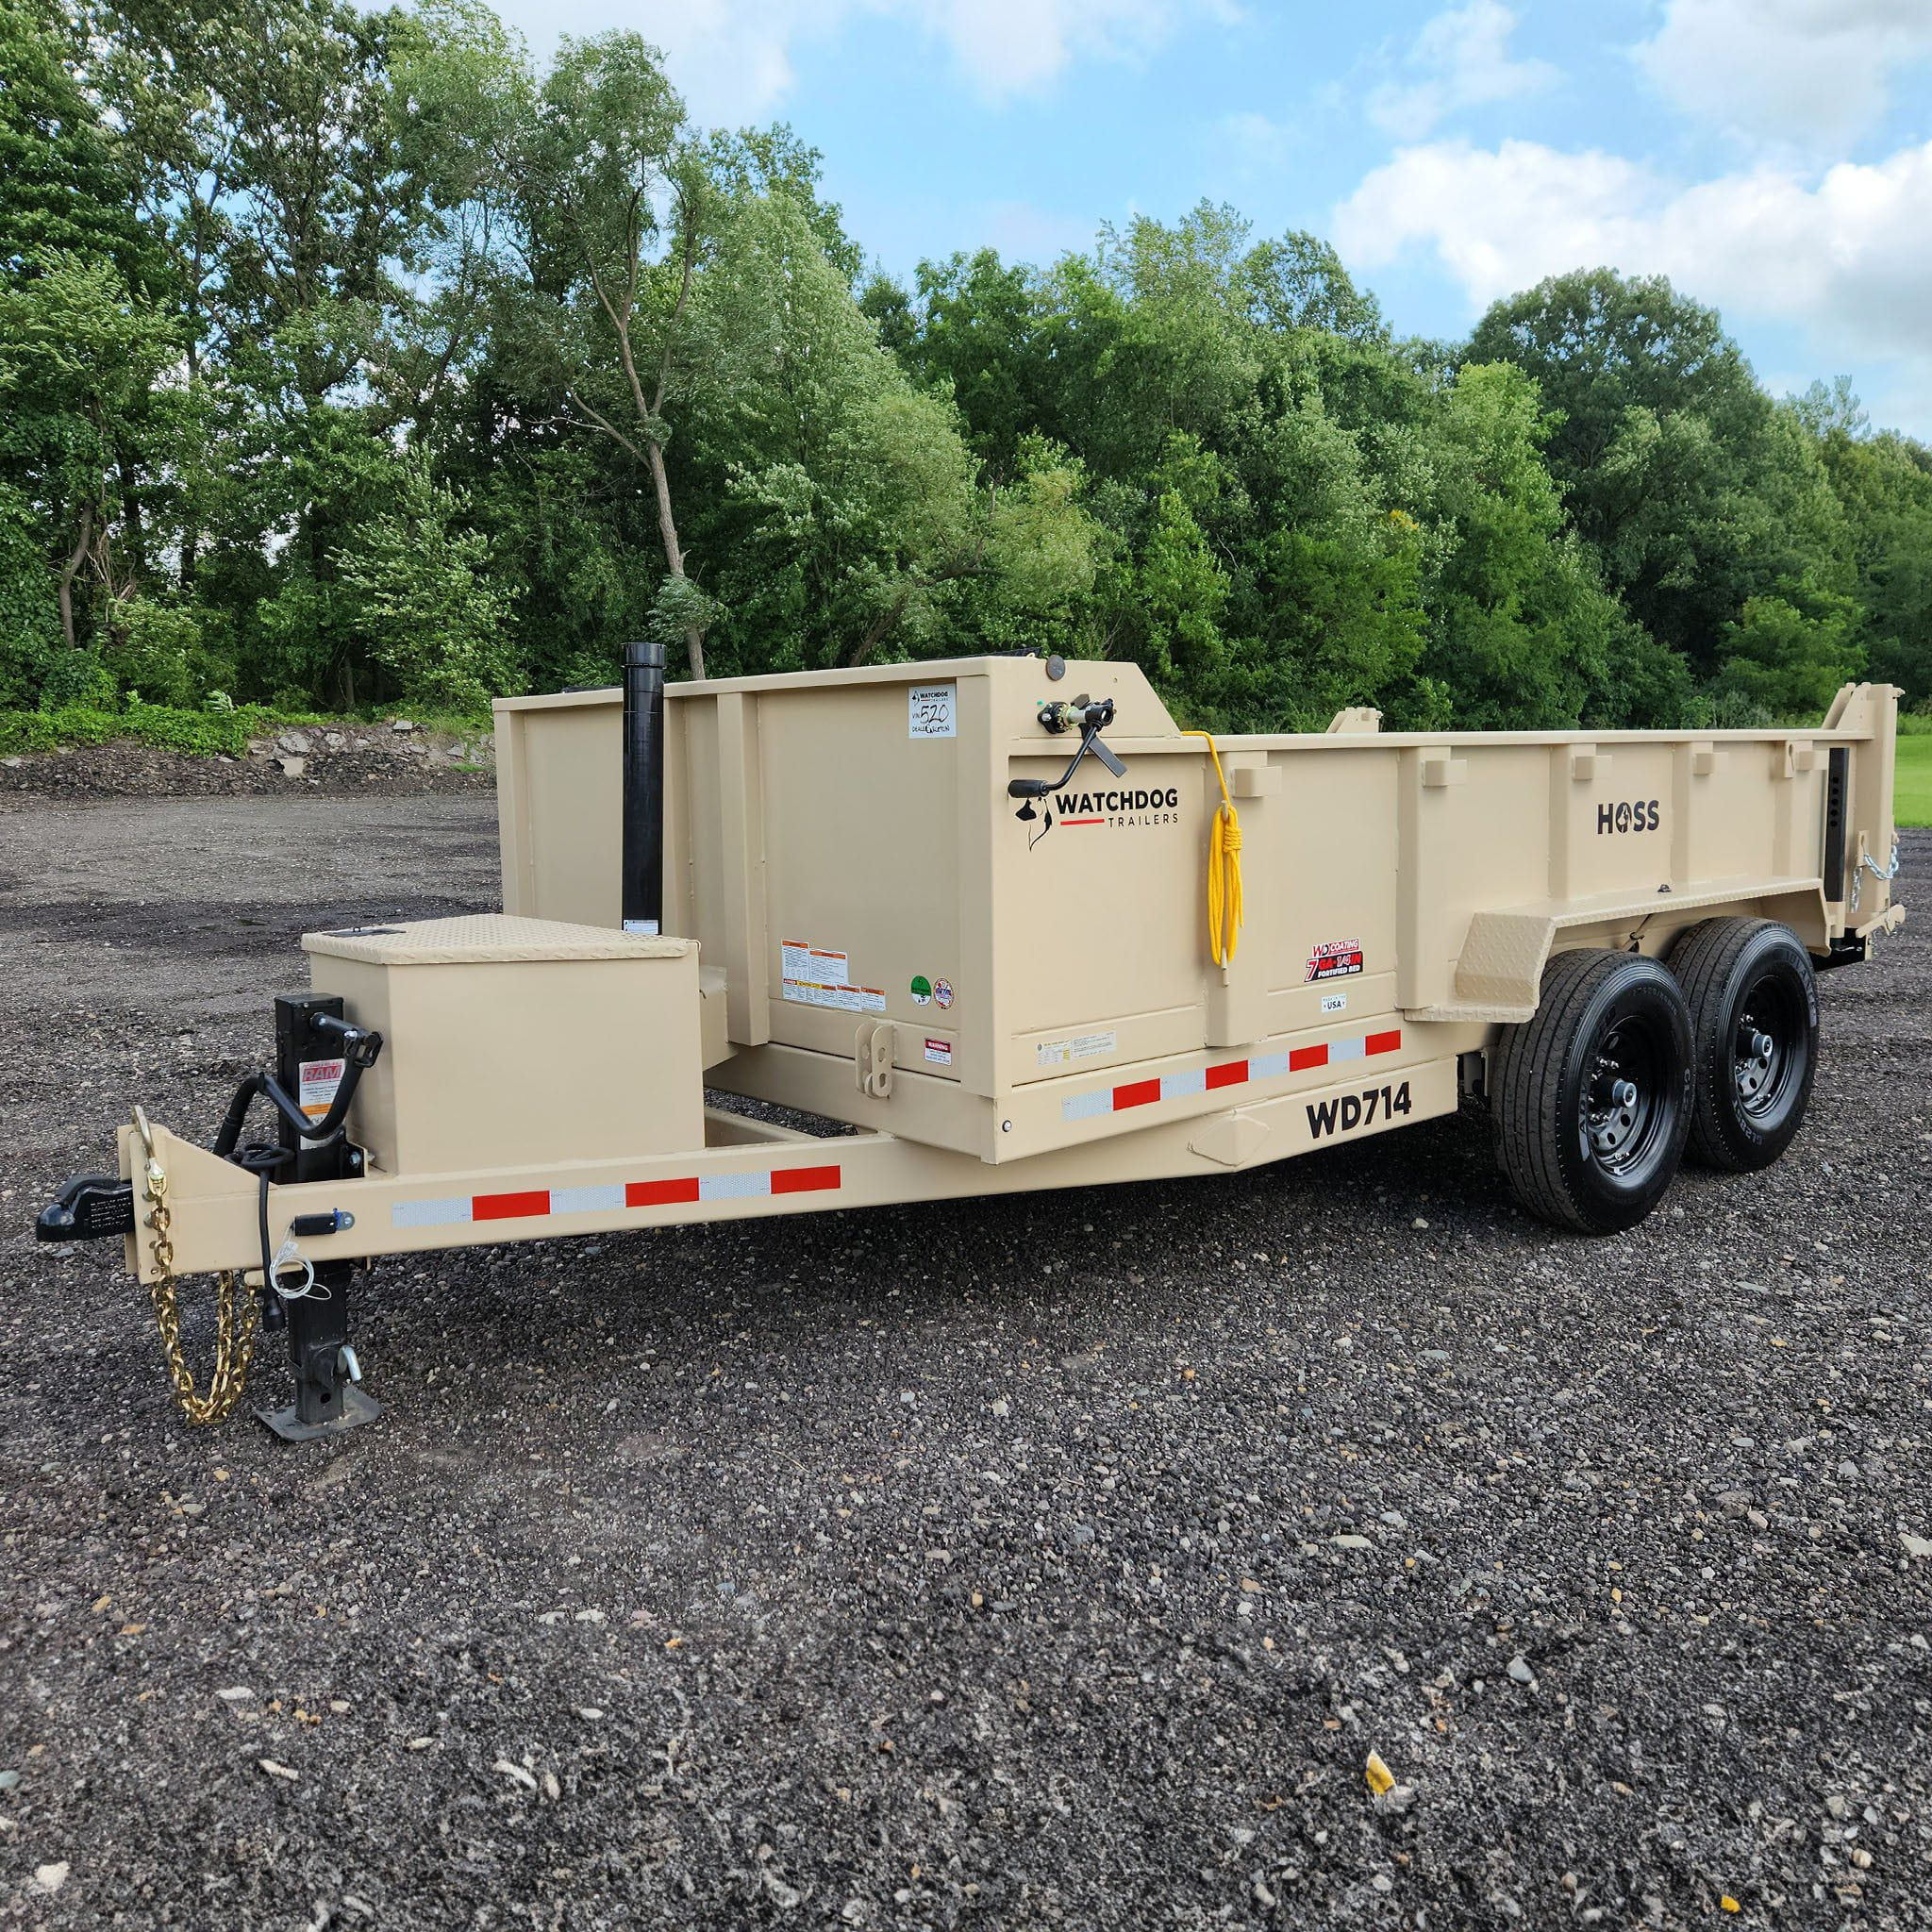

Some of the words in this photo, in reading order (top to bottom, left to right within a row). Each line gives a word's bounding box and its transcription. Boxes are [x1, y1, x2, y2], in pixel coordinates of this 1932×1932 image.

[920, 704, 949, 724] 520
[1055, 788, 1178, 815] WATCHDOG
[1108, 813, 1178, 827] TRAILERS
[1597, 800, 1659, 835] HOSS
[1330, 940, 1358, 951] COATING
[1317, 967, 1348, 978] FORTIFIED
[1348, 964, 1360, 973] BED
[1327, 1001, 1341, 1009] USA
[303, 1066, 341, 1081] RAM
[1306, 1081, 1412, 1140] WD714
